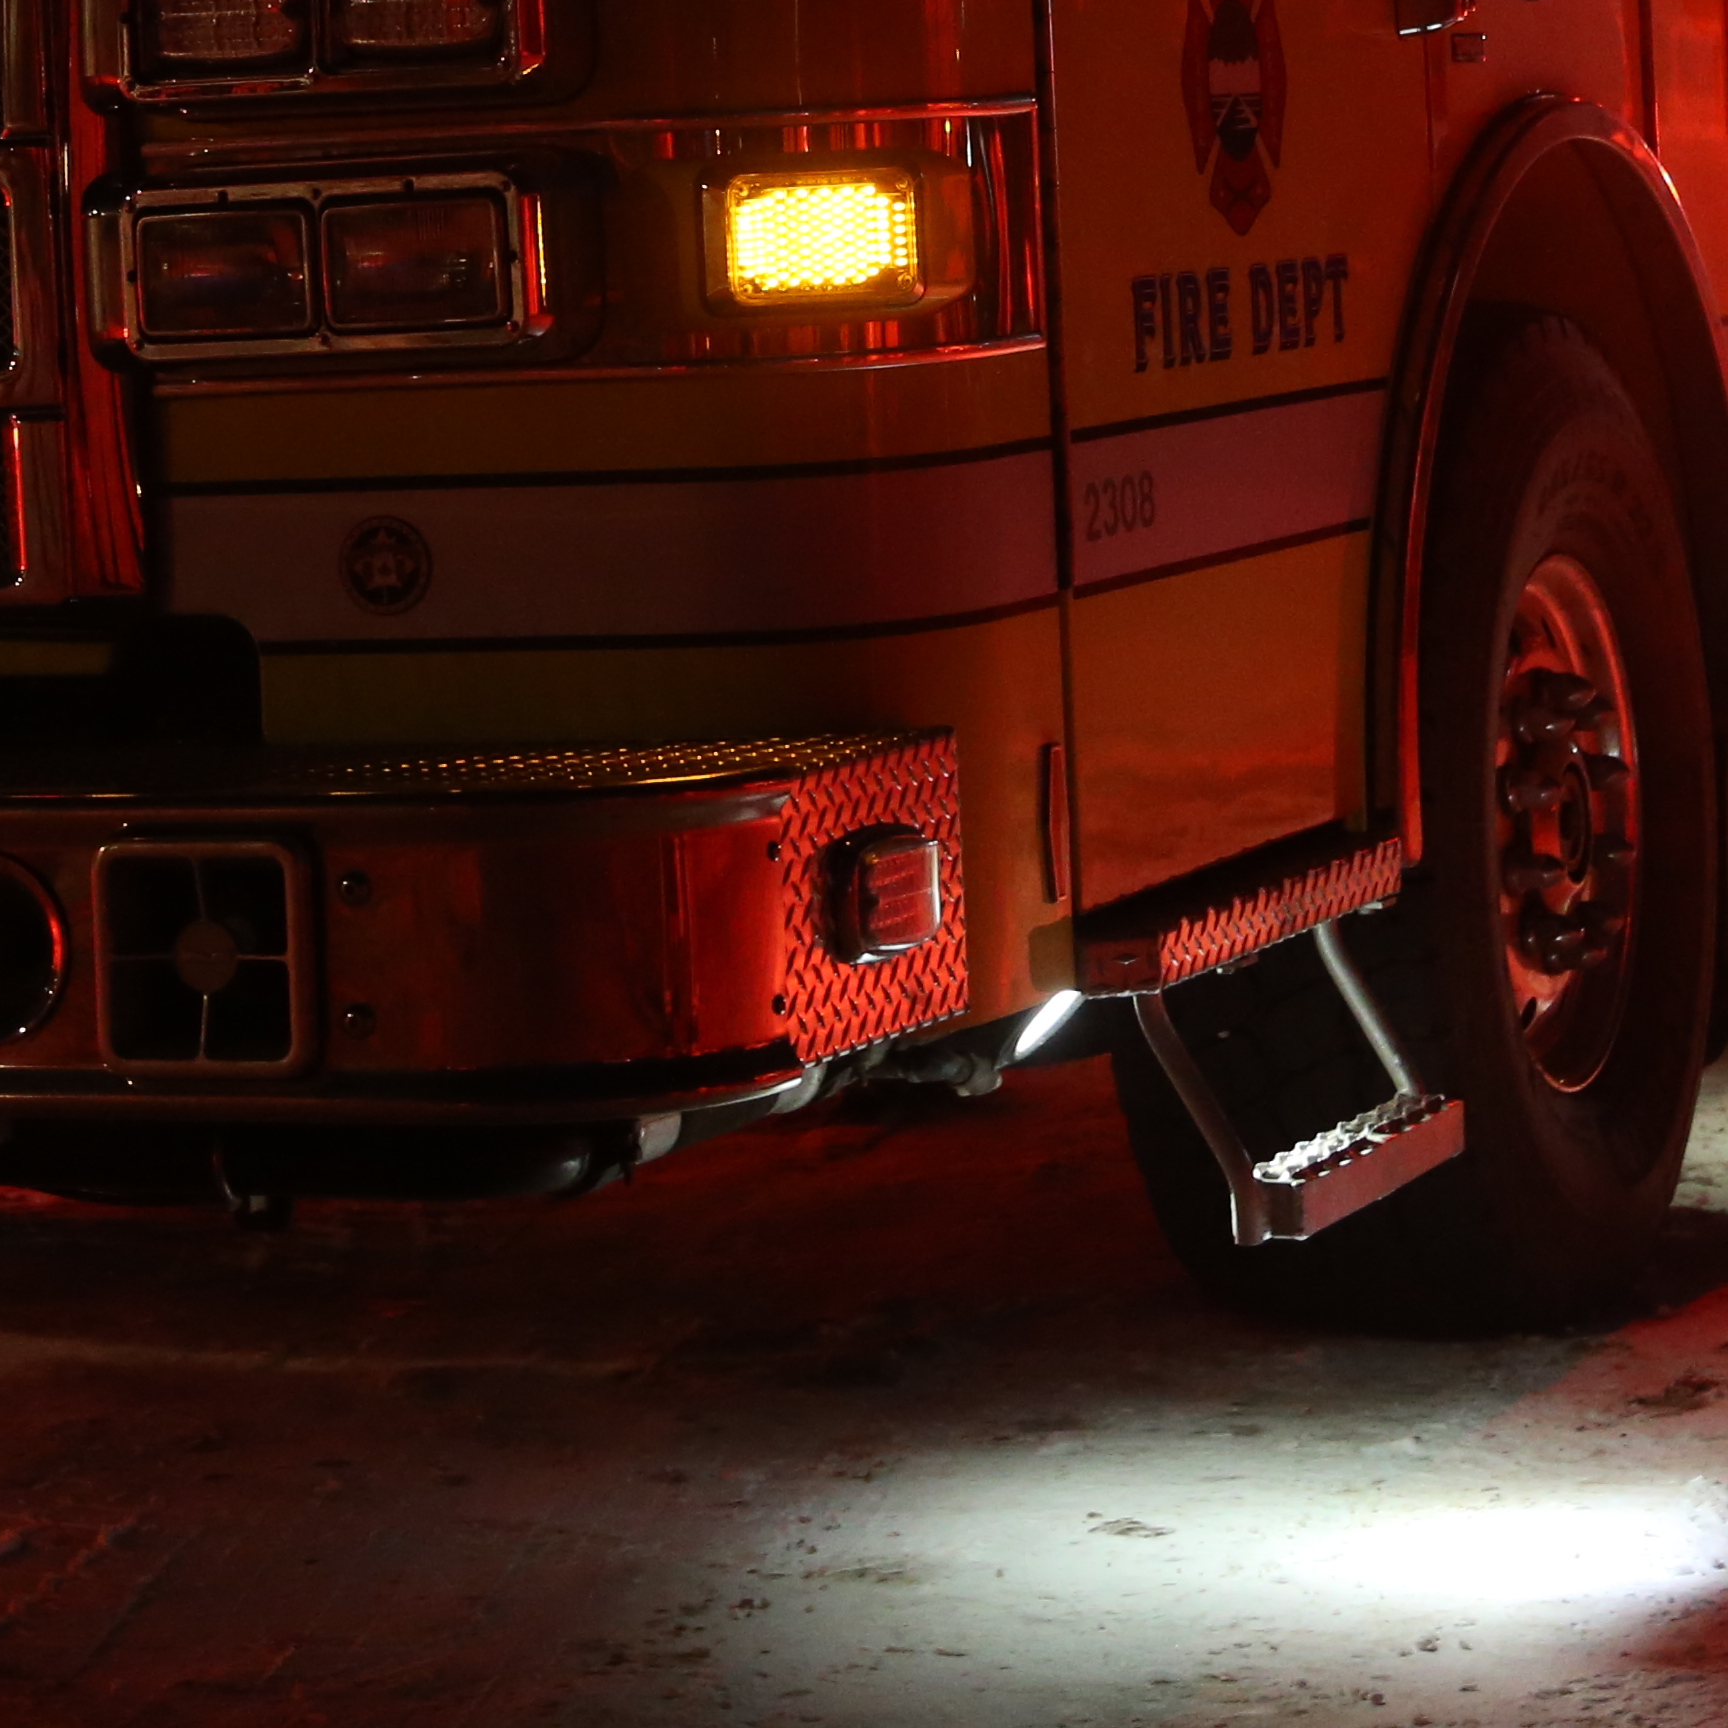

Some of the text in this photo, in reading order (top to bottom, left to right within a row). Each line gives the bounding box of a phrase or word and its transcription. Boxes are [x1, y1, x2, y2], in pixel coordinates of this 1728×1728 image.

[1131, 253, 1350, 373] FIRE DEPT
[1083, 470, 1155, 542] 2308
